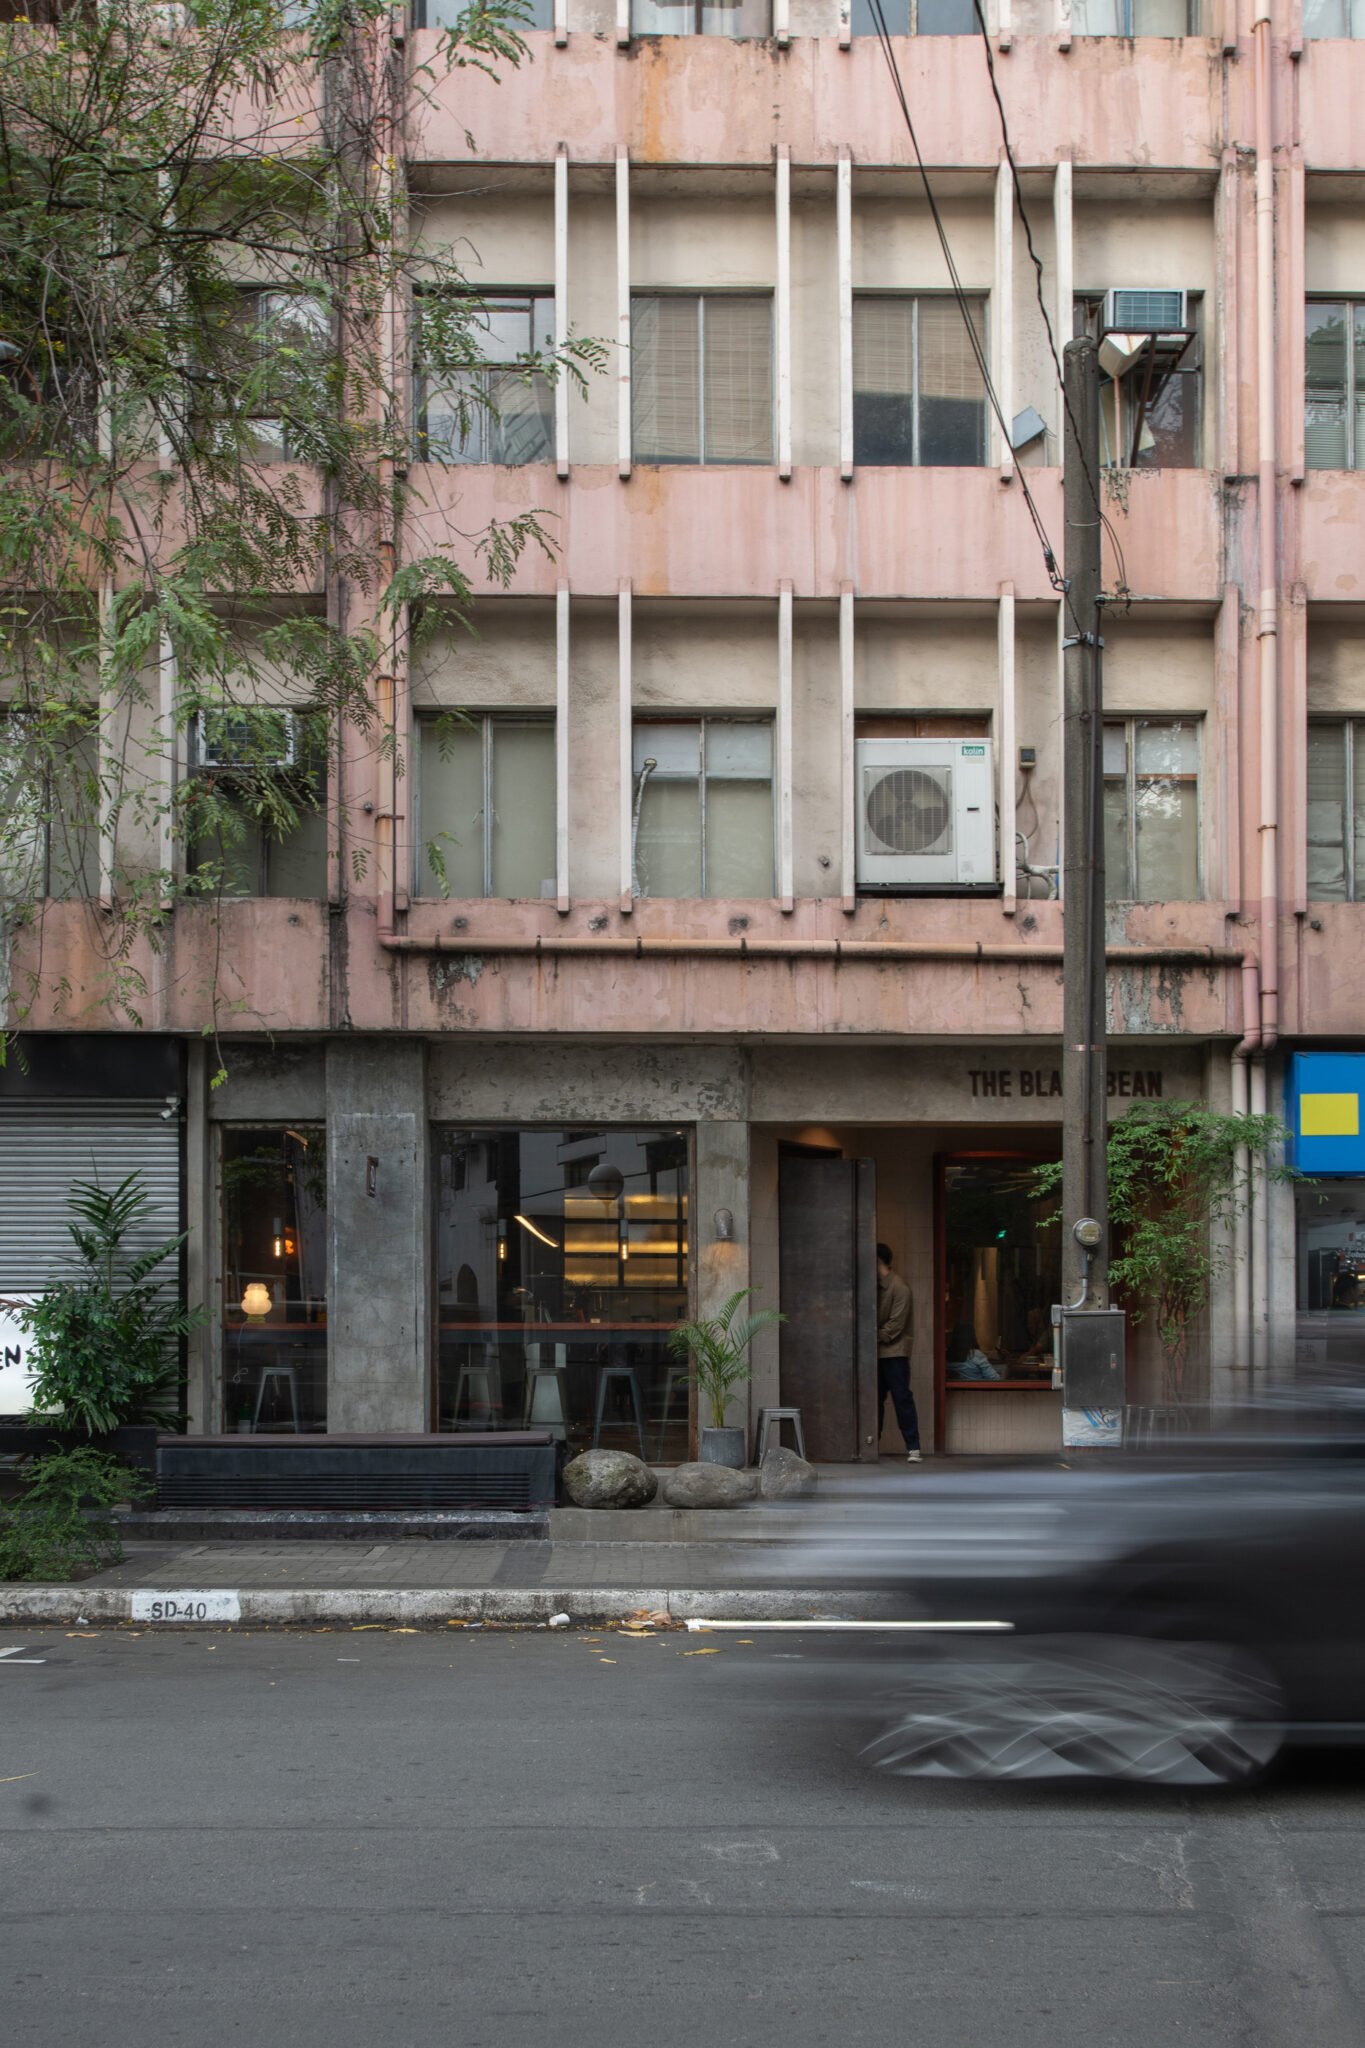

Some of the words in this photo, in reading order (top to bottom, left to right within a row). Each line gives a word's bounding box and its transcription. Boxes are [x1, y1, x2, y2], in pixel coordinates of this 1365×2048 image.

[968, 1070, 1012, 1097] THE
[1020, 1070, 1064, 1097] BLA
[1106, 1070, 1163, 1097] BEAN
[151, 1601, 207, 1620] SD-40
